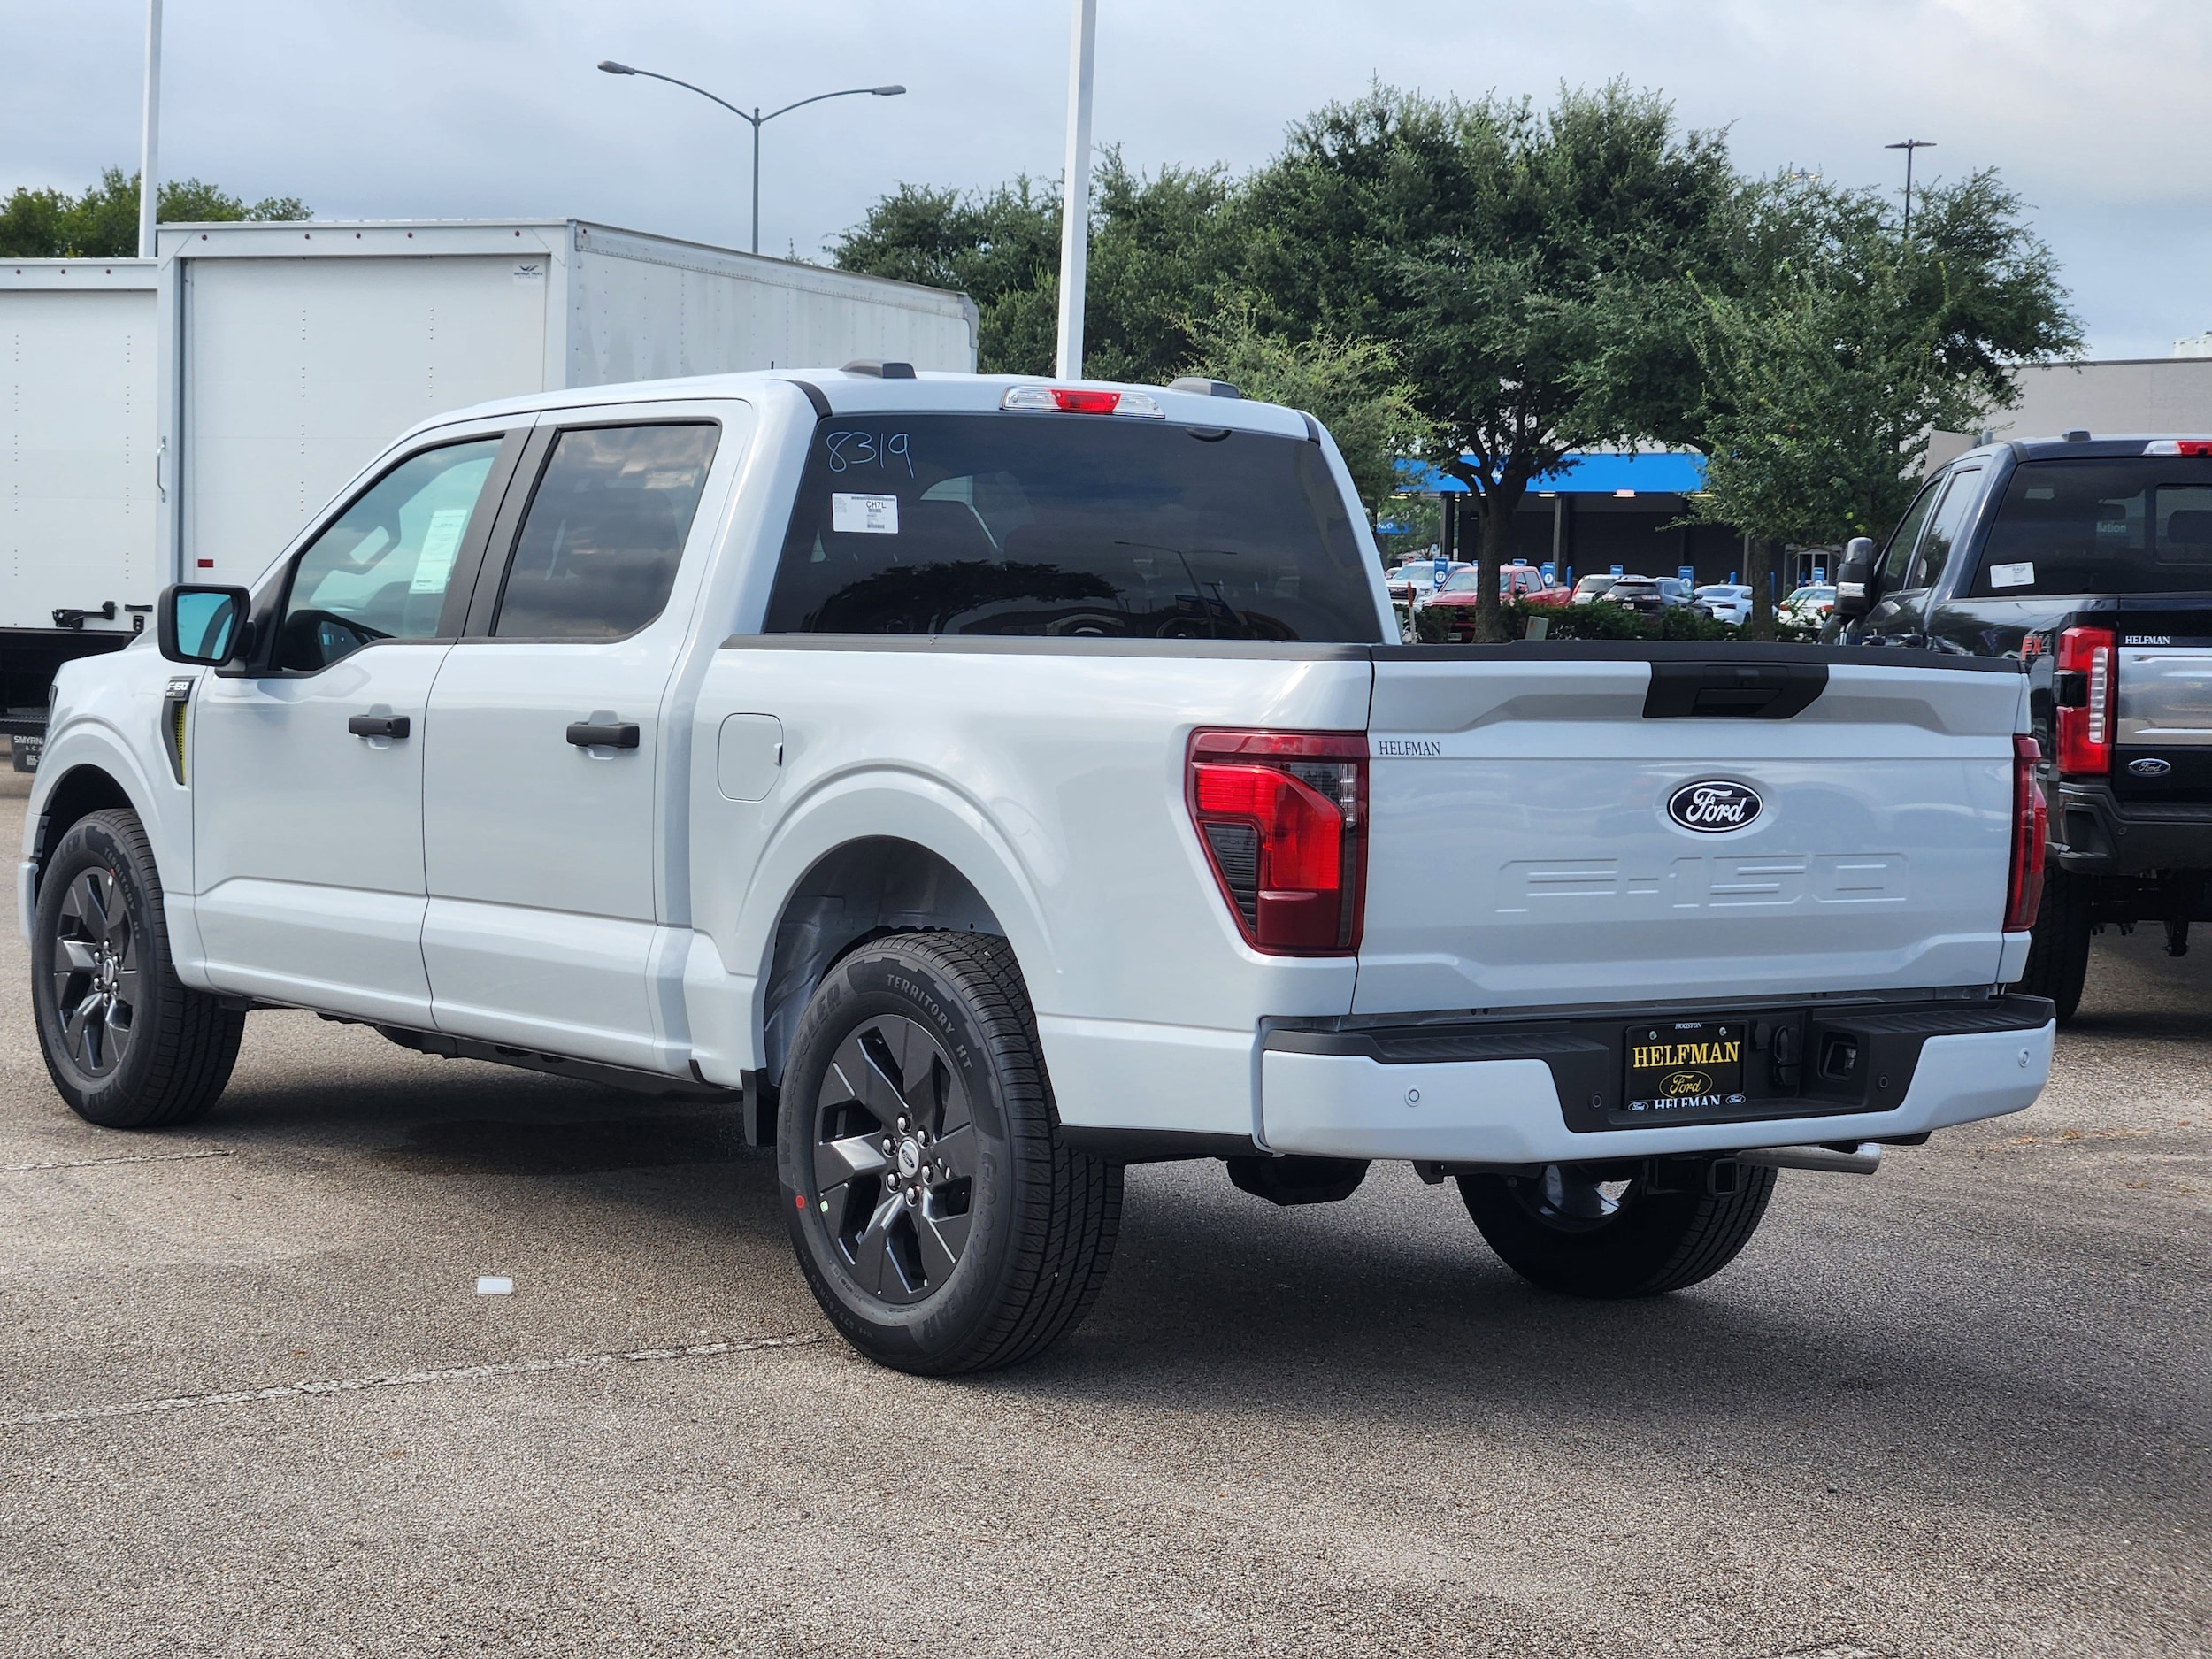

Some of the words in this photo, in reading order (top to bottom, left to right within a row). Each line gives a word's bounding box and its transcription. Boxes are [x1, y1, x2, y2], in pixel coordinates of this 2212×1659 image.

[826, 432, 914, 478] 8319
[2021, 634, 2052, 662] FX4
[2125, 635, 2170, 644] HELFMAN
[1379, 741, 1440, 756] HELFMAN
[2138, 762, 2162, 772] Ford
[1686, 787, 1747, 823] Ford
[887, 973, 956, 1034] TERRITORY
[956, 1044, 972, 1069] HT
[1632, 1041, 1740, 1069] HELFMAN
[1669, 1073, 1703, 1094] Ford
